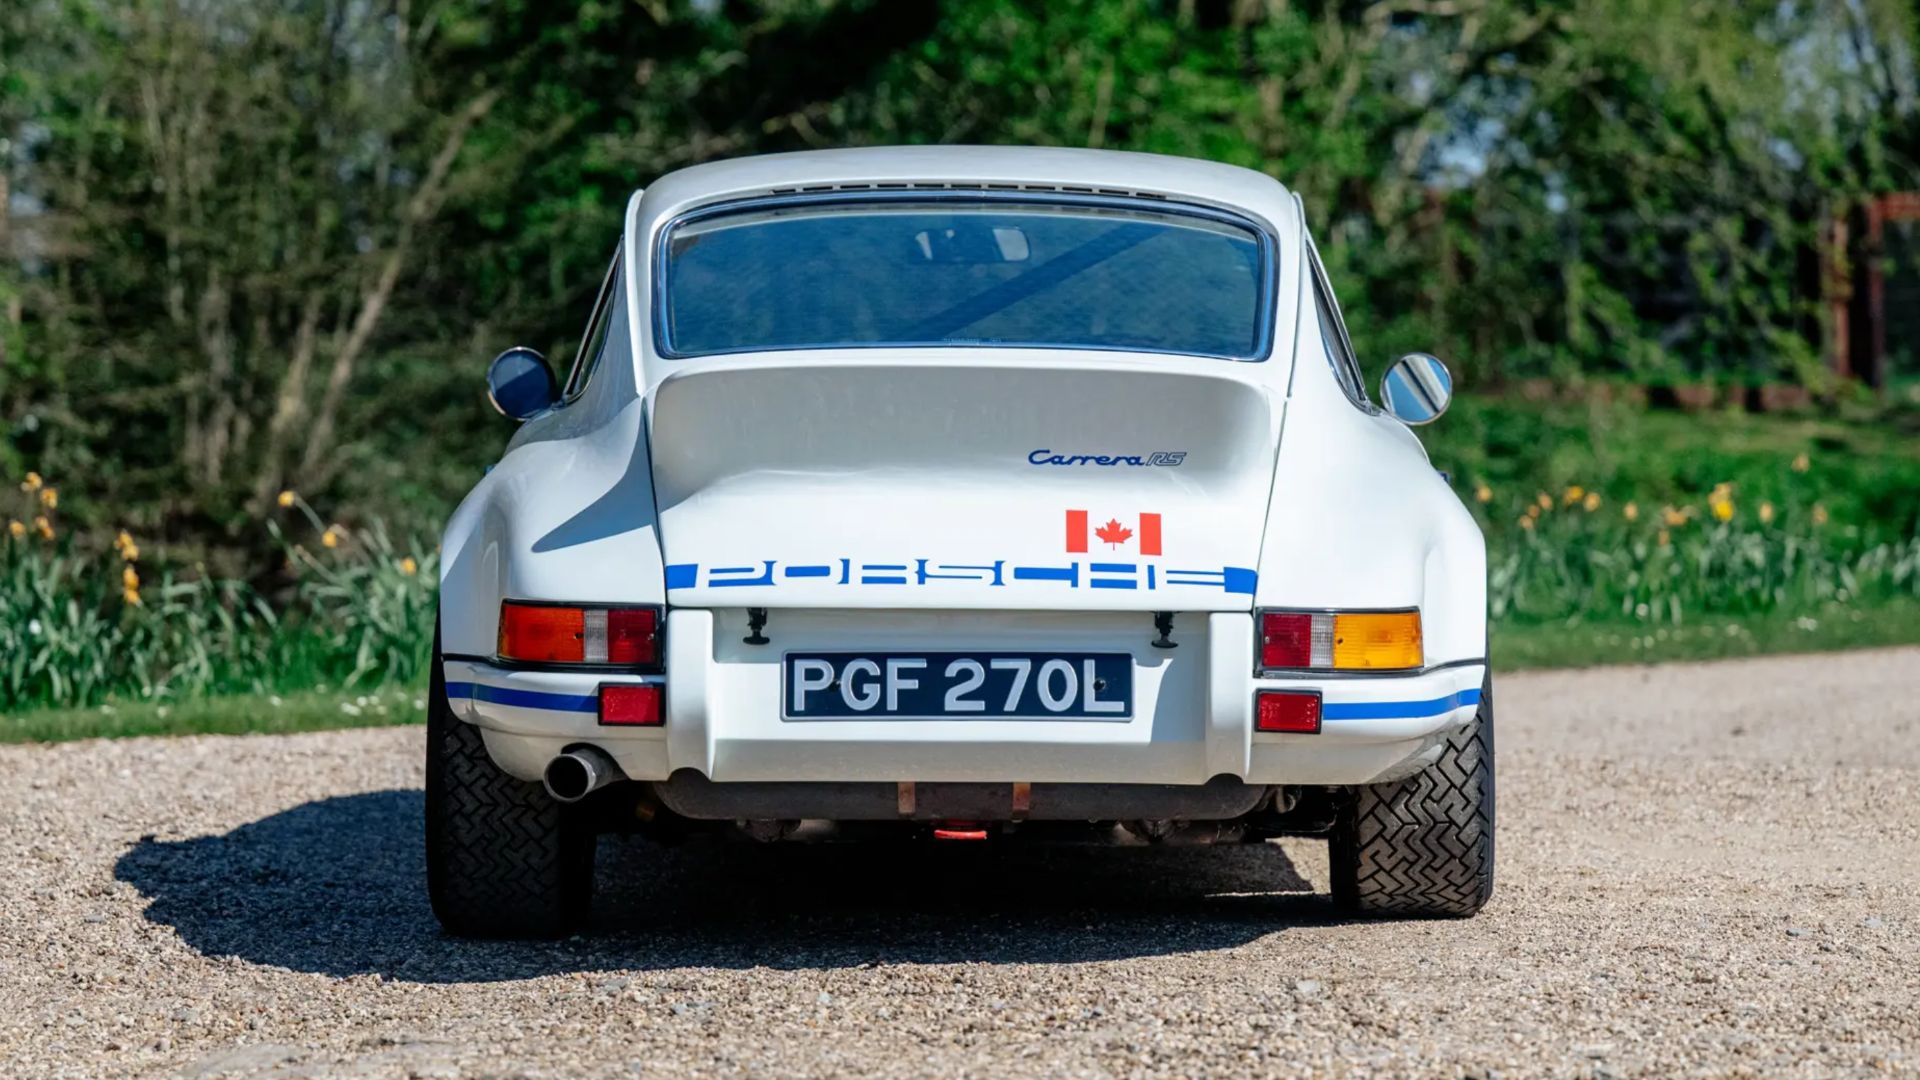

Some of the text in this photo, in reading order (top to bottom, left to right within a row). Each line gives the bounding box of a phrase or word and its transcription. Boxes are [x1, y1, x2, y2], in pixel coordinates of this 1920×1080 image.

[1028, 449, 1187, 466] Carrera RS
[692, 558, 1227, 591] PORSCHE
[793, 658, 1125, 713] PGF 270L
